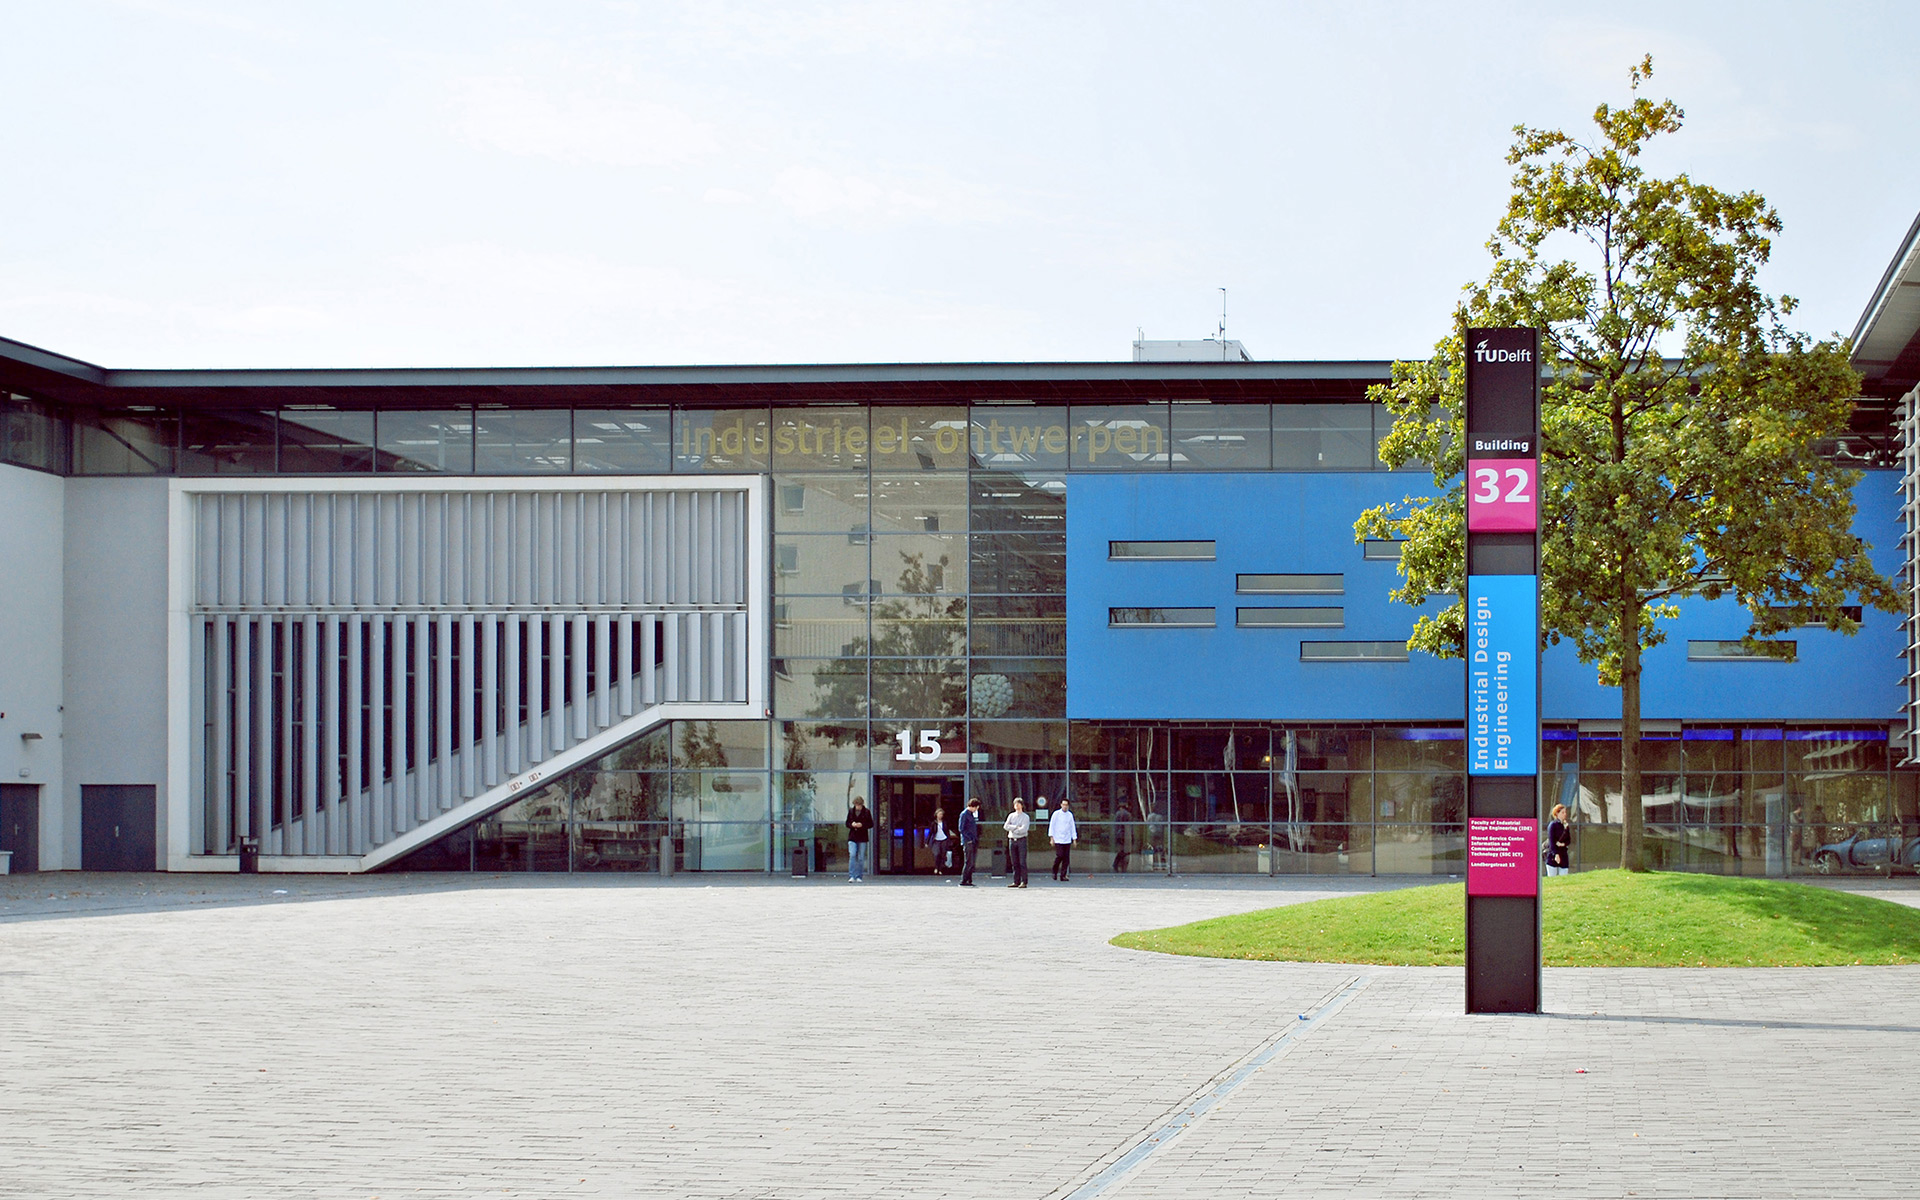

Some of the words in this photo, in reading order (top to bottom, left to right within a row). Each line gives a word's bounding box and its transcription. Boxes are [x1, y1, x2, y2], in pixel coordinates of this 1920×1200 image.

[682, 417, 909, 456] industrieel
[936, 419, 1165, 462] ontwerpen
[1475, 440, 1529, 452] Building
[1473, 468, 1531, 504] 32
[1474, 596, 1492, 663] Design
[1474, 671, 1488, 770] Industrial
[1494, 651, 1511, 770] Engineering
[896, 730, 941, 761] 15
